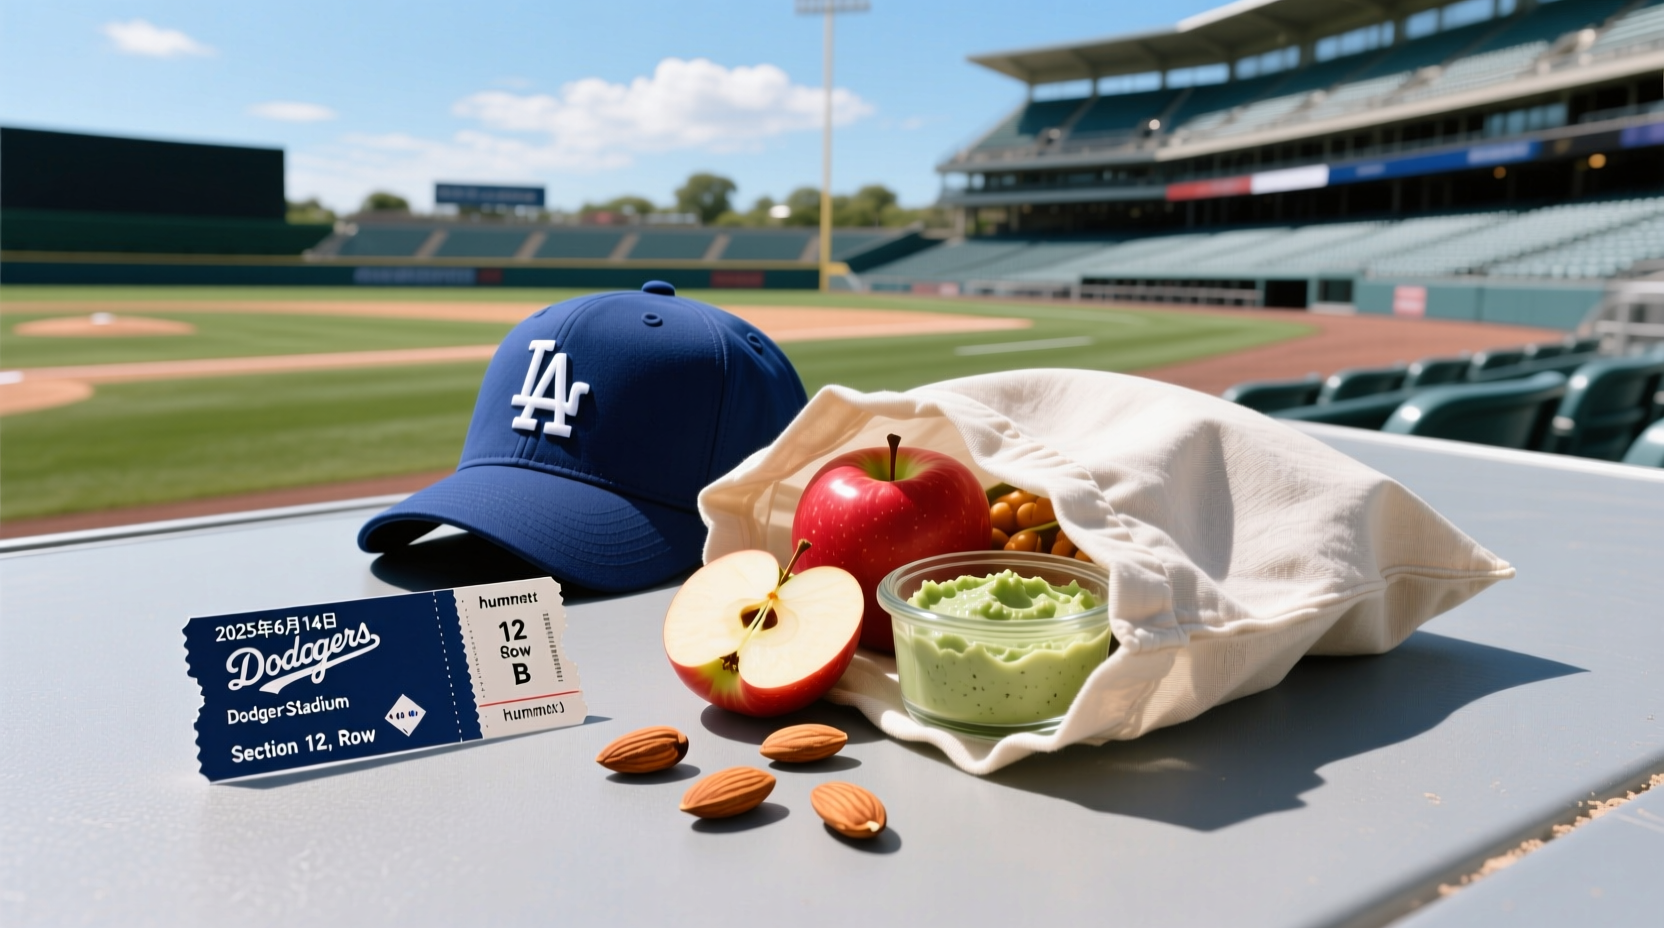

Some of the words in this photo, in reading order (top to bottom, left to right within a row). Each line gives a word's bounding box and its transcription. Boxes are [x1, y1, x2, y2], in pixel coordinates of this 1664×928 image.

[511, 339, 590, 438] LA
[215, 612, 337, 642] 2025年6月14日
[498, 619, 528, 642] 12
[512, 663, 531, 685] B
[231, 740, 299, 763] Section
[305, 733, 333, 752] 12,
[338, 729, 376, 747] Row
